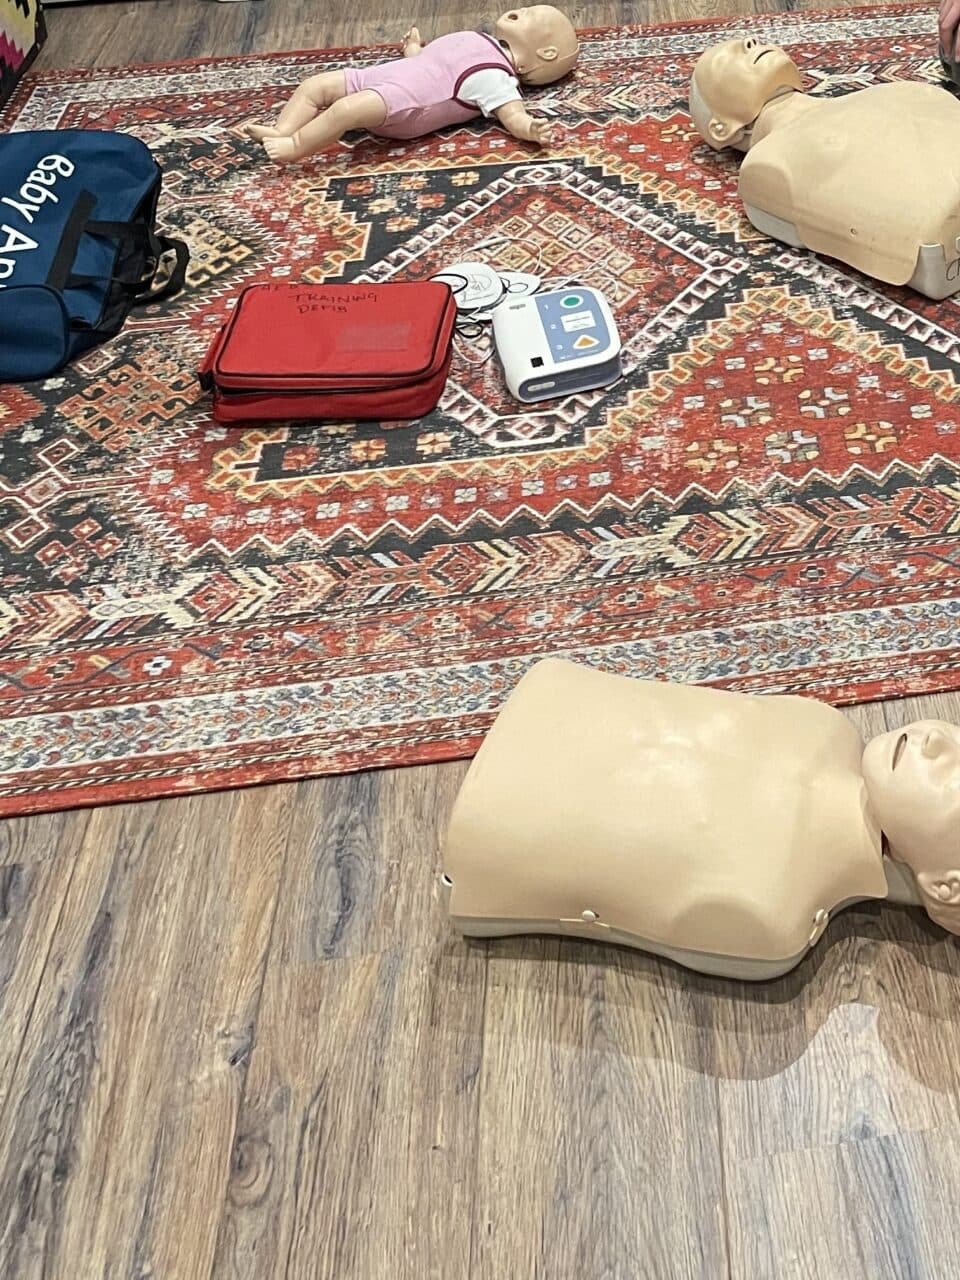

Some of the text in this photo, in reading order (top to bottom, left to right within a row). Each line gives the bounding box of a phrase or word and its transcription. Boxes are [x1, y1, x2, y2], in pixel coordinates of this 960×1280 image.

[0, 154, 75, 288] Baby An
[288, 292, 378, 303] TRAINING
